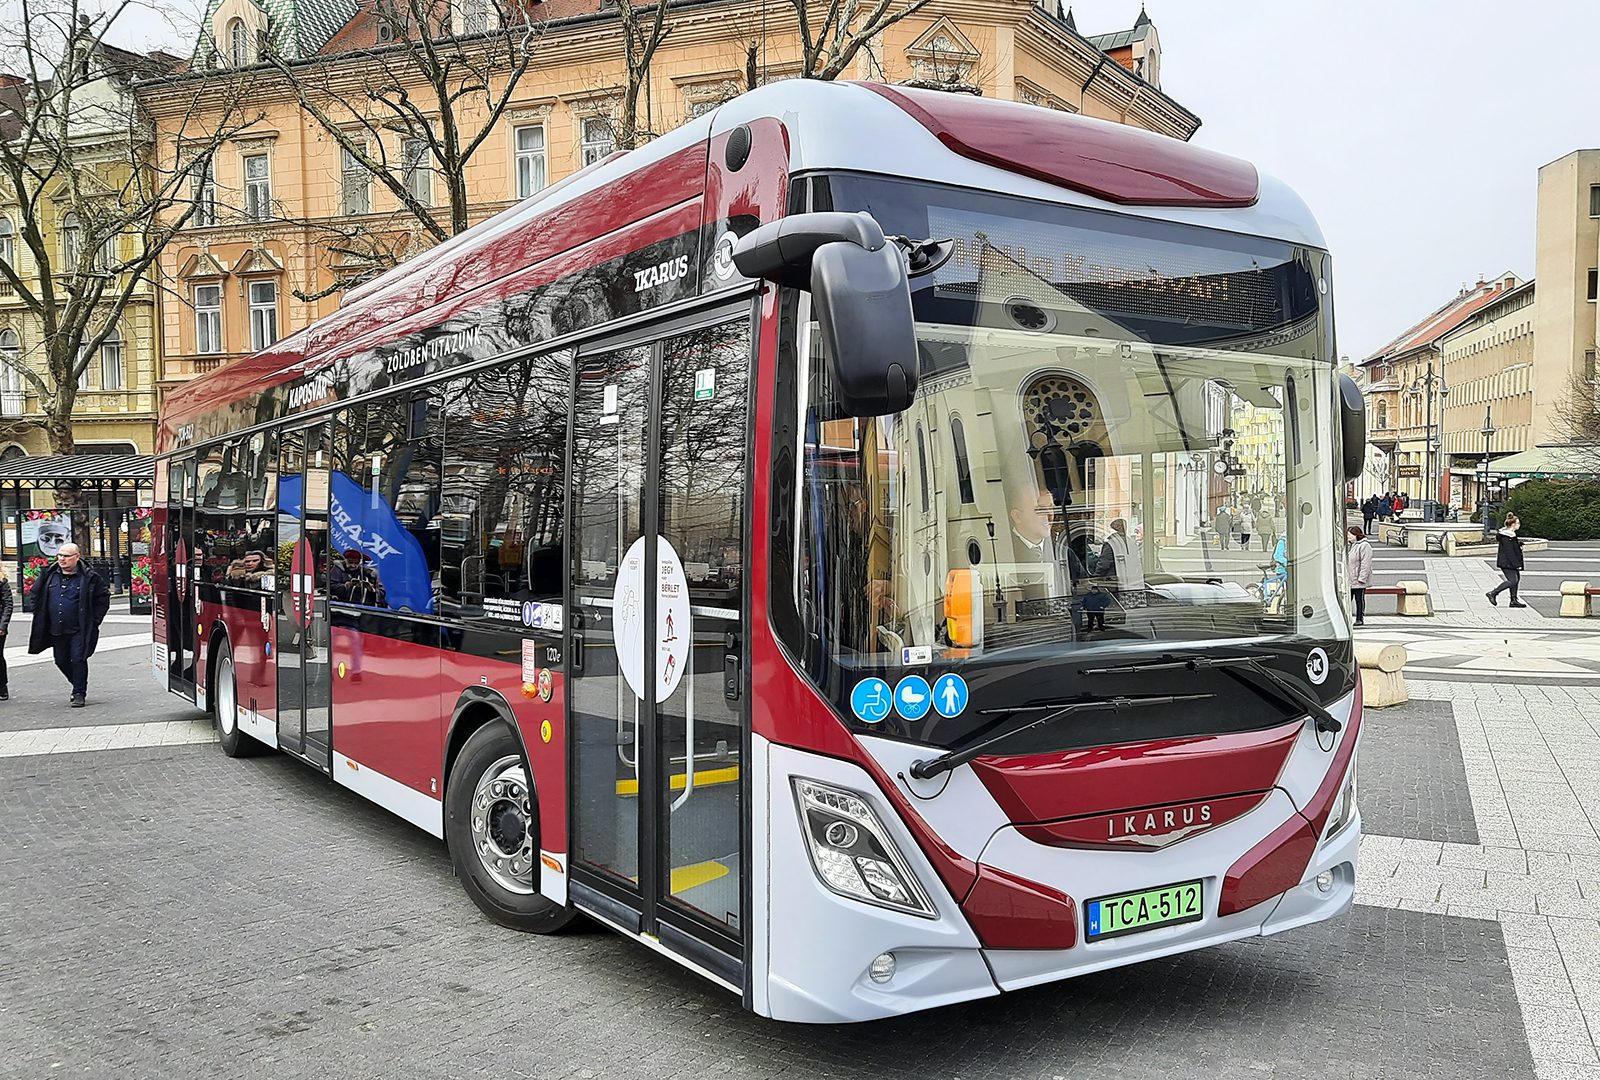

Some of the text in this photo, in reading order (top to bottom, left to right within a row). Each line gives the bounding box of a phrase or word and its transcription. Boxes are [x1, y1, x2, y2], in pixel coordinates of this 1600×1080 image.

[633, 254, 688, 293] IKARUS
[387, 324, 481, 374] ZÖLDBEN UTAZUNK
[1108, 805, 1212, 836] IKARUS
[1091, 887, 1197, 931] H TCA-512
